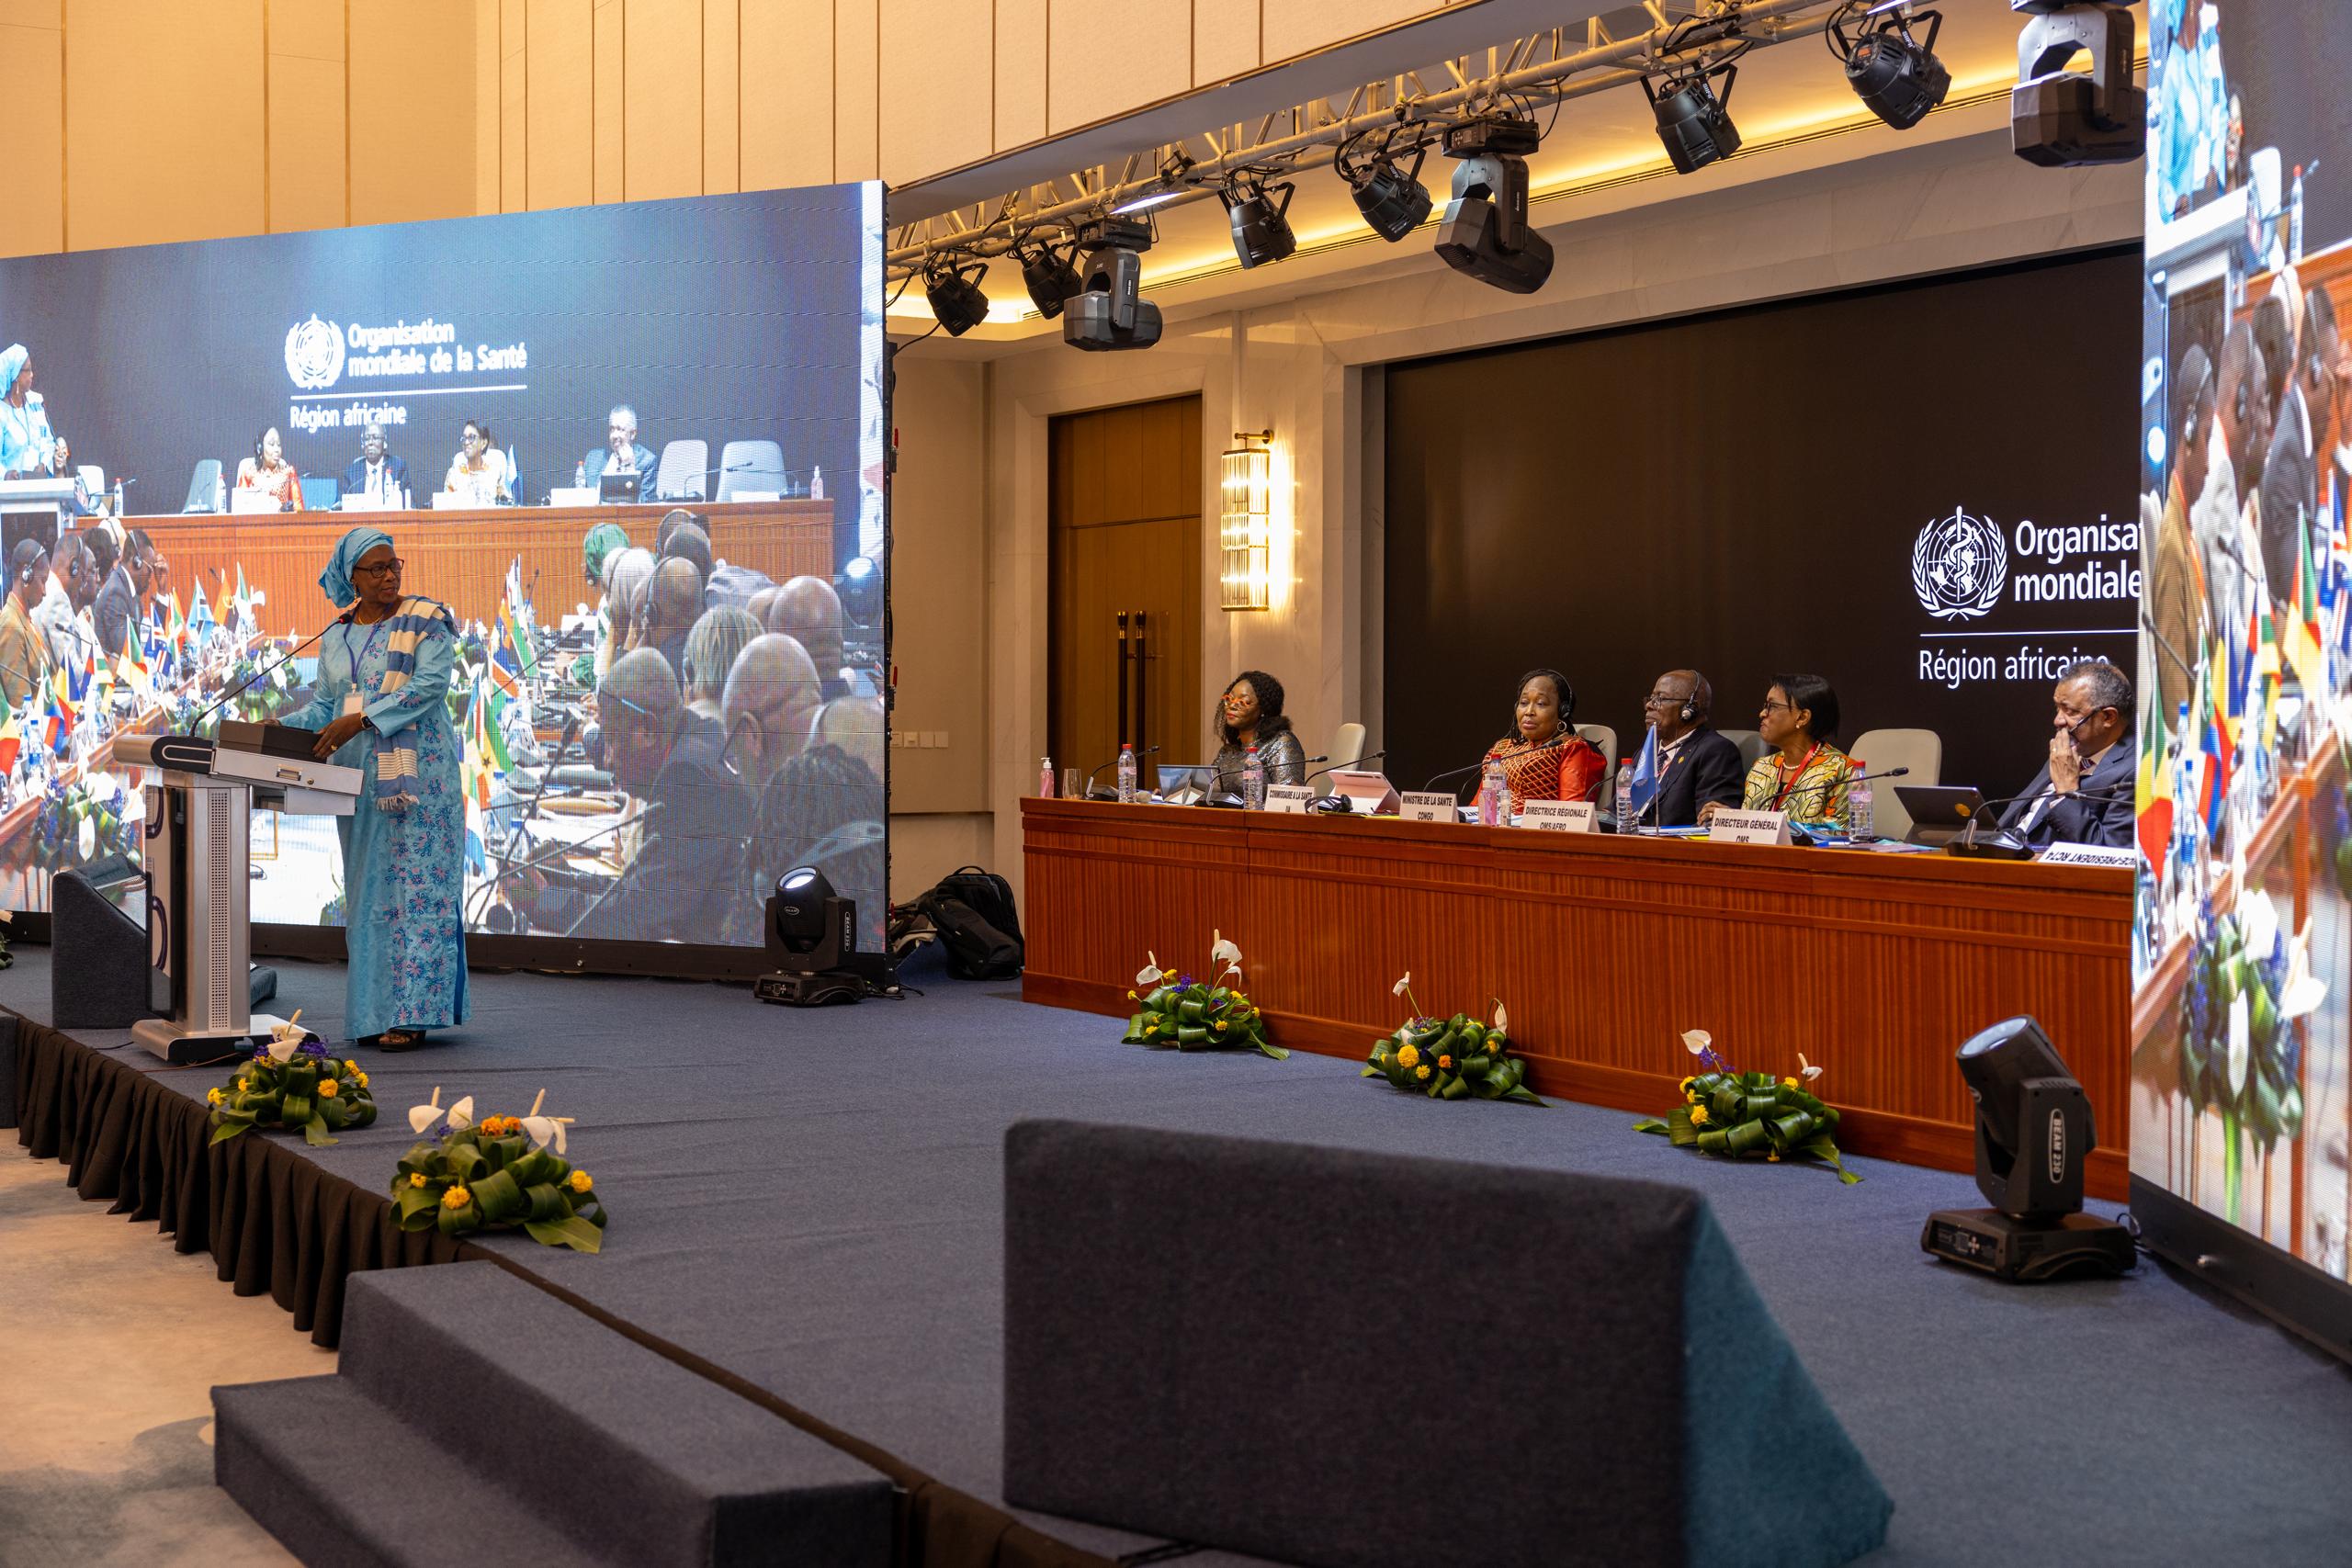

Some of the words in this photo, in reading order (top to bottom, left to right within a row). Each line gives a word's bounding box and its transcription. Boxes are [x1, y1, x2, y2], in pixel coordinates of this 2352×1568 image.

[348, 318, 455, 353] Organisation
[348, 347, 426, 377] mondiale
[430, 346, 453, 373] de
[457, 344, 473, 371] la
[477, 342, 527, 370] Santé
[290, 405, 340, 434] Région
[344, 401, 407, 426] africaine
[2016, 514, 2142, 565] Organisa
[1919, 649, 1996, 689] Région
[1402, 795, 1423, 805] MINISTRE
[1423, 795, 1430, 805] DE
[1430, 795, 1436, 806] LA
[1418, 811, 1433, 820] CONGO
[1525, 807, 1556, 816] DIRECTRICE
[1557, 807, 1588, 818] RÉGIONALE
[1714, 818, 1748, 829] DIRECTEUR
[1749, 818, 1778, 830] GÉNÉRAL
[2053, 1118, 2062, 1151] BEAM
[2052, 1153, 2062, 1173] 230
